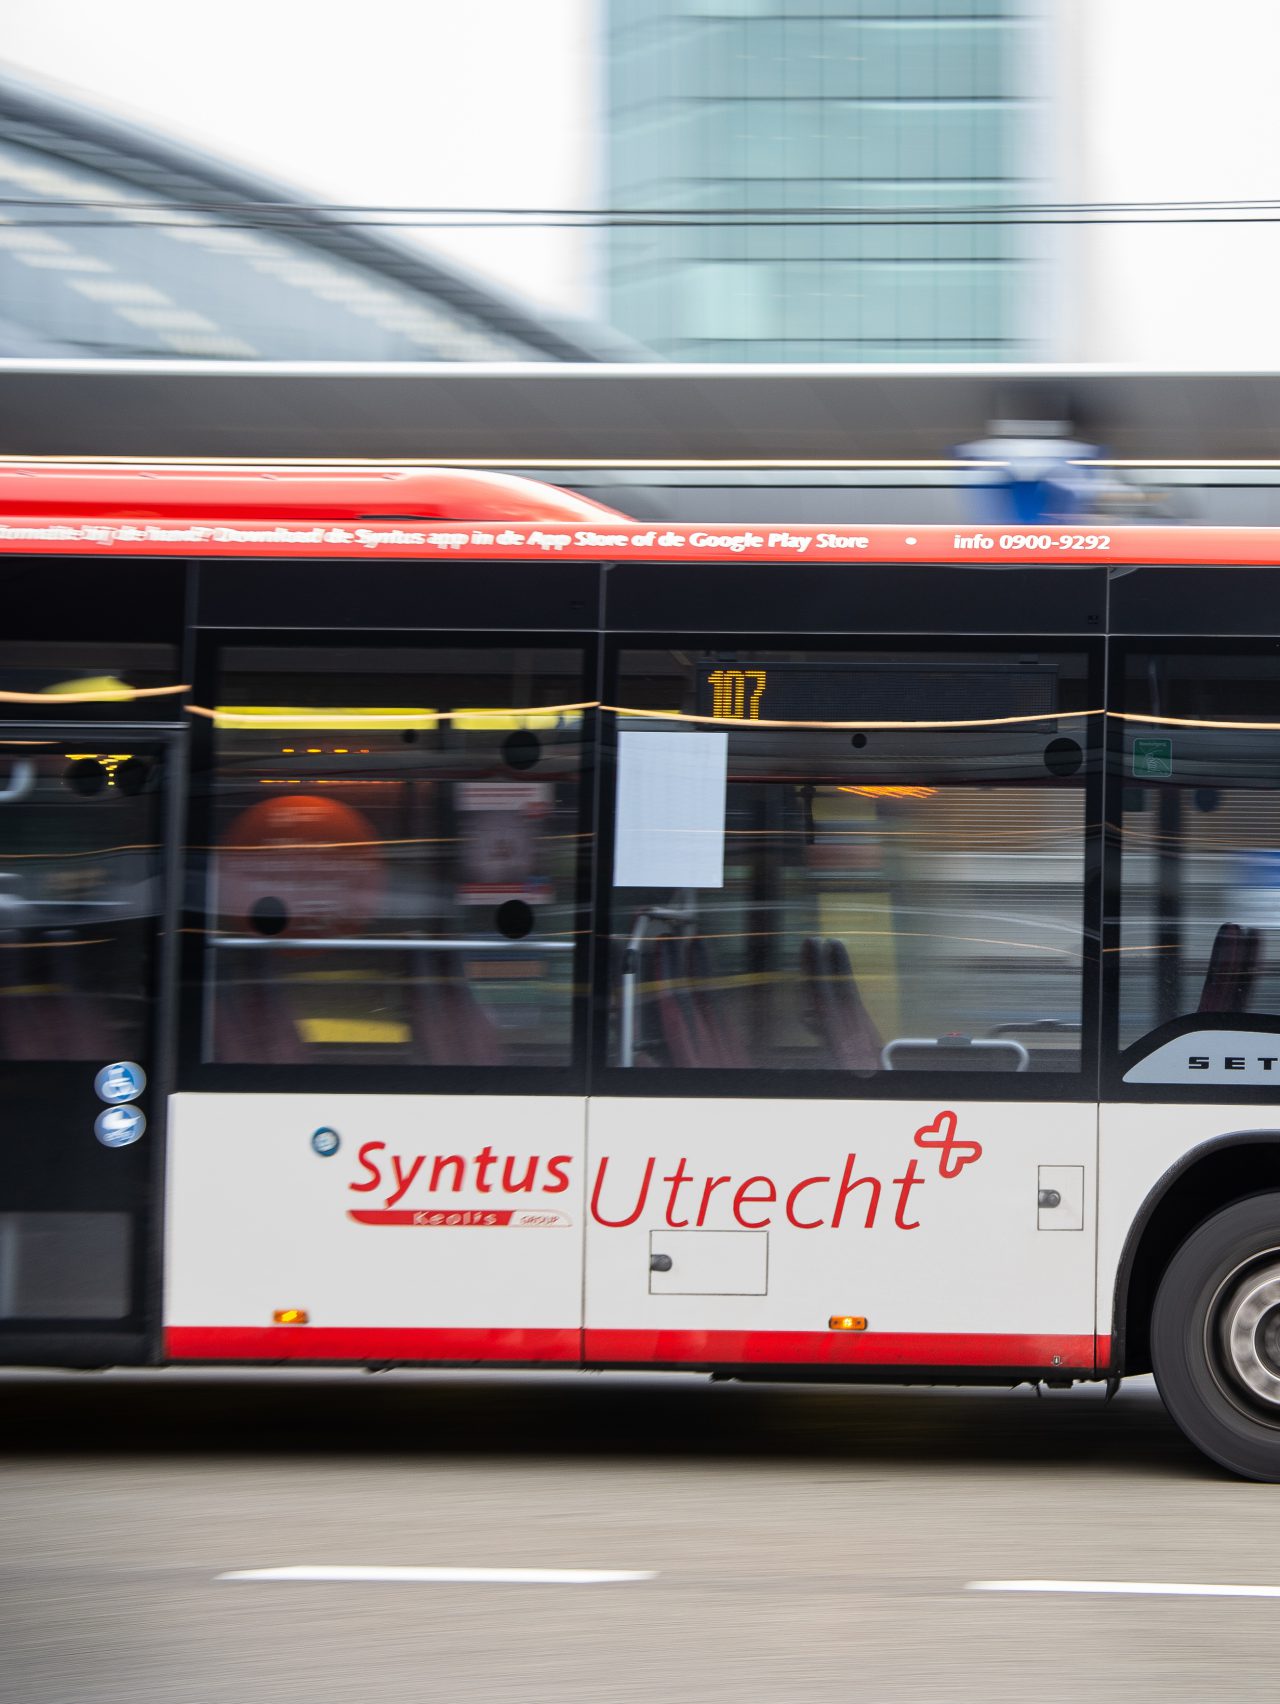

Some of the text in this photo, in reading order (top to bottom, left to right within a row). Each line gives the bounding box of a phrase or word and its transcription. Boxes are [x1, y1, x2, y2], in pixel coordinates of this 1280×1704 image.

[355, 528, 427, 549] Syntus
[426, 532, 470, 550] app
[470, 530, 494, 545] in
[495, 529, 525, 546] de
[526, 530, 572, 551] App
[573, 531, 629, 547] Store
[631, 531, 657, 547] of
[657, 531, 685, 547] de
[689, 532, 763, 552] Google
[768, 532, 811, 552] Play
[816, 533, 869, 549] Store
[953, 533, 994, 549] info
[999, 534, 1111, 550] 0900-9292
[707, 670, 767, 720] 107
[348, 1141, 925, 1230] Syntus Utrecht
[413, 1211, 497, 1226] Keolis
